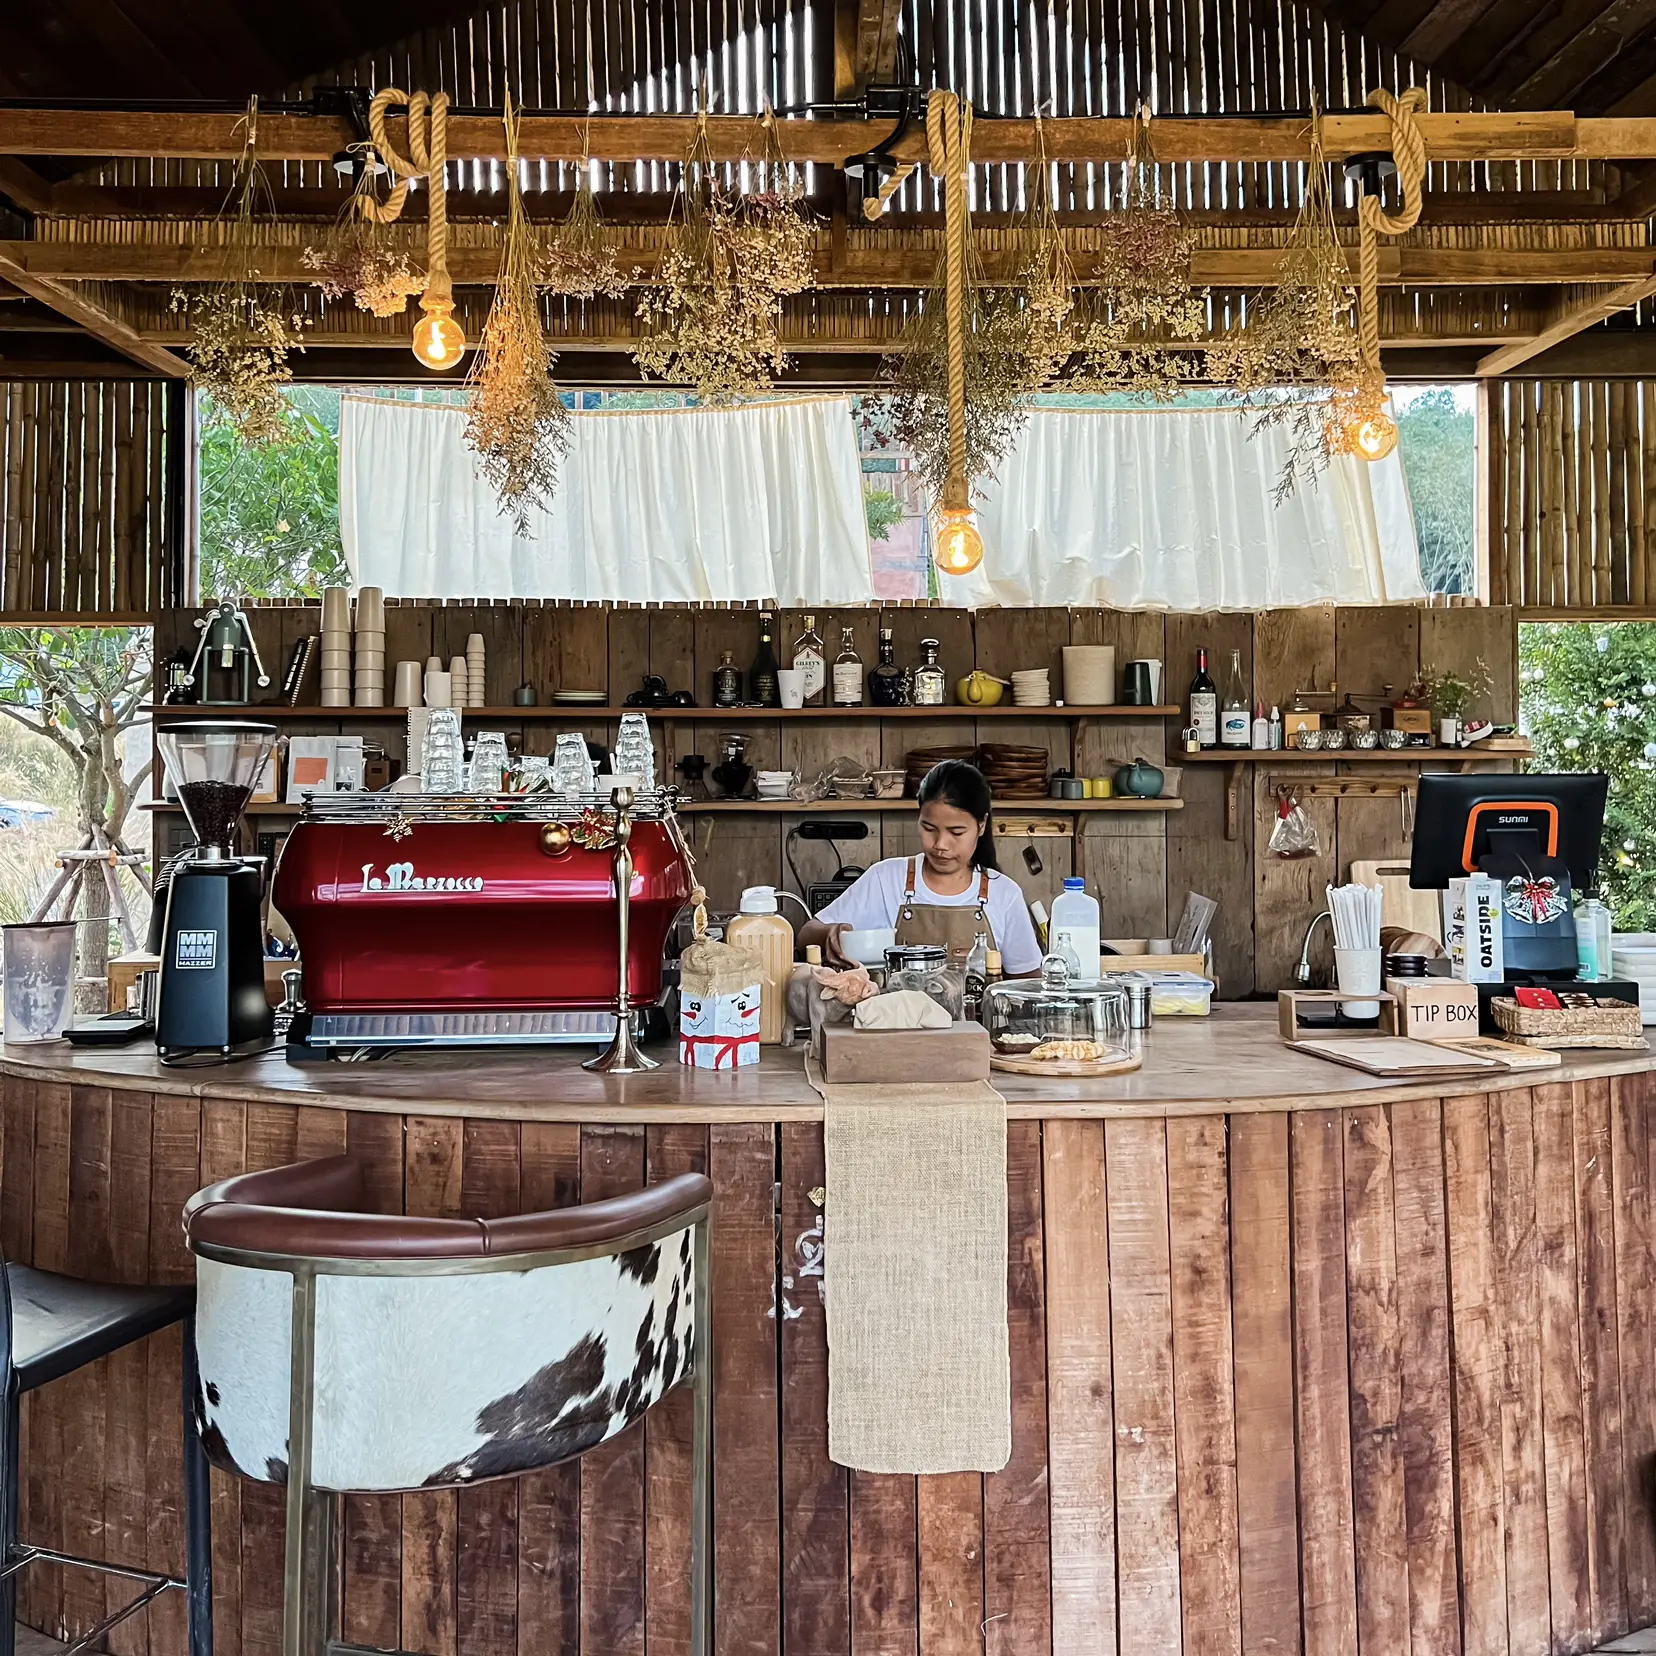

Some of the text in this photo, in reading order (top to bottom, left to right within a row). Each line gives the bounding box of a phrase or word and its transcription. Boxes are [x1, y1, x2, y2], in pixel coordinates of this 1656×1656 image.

[360, 863, 382, 892] La
[1477, 895, 1493, 968] OATSIDE
[1410, 1004, 1477, 1022] TIP BOX
